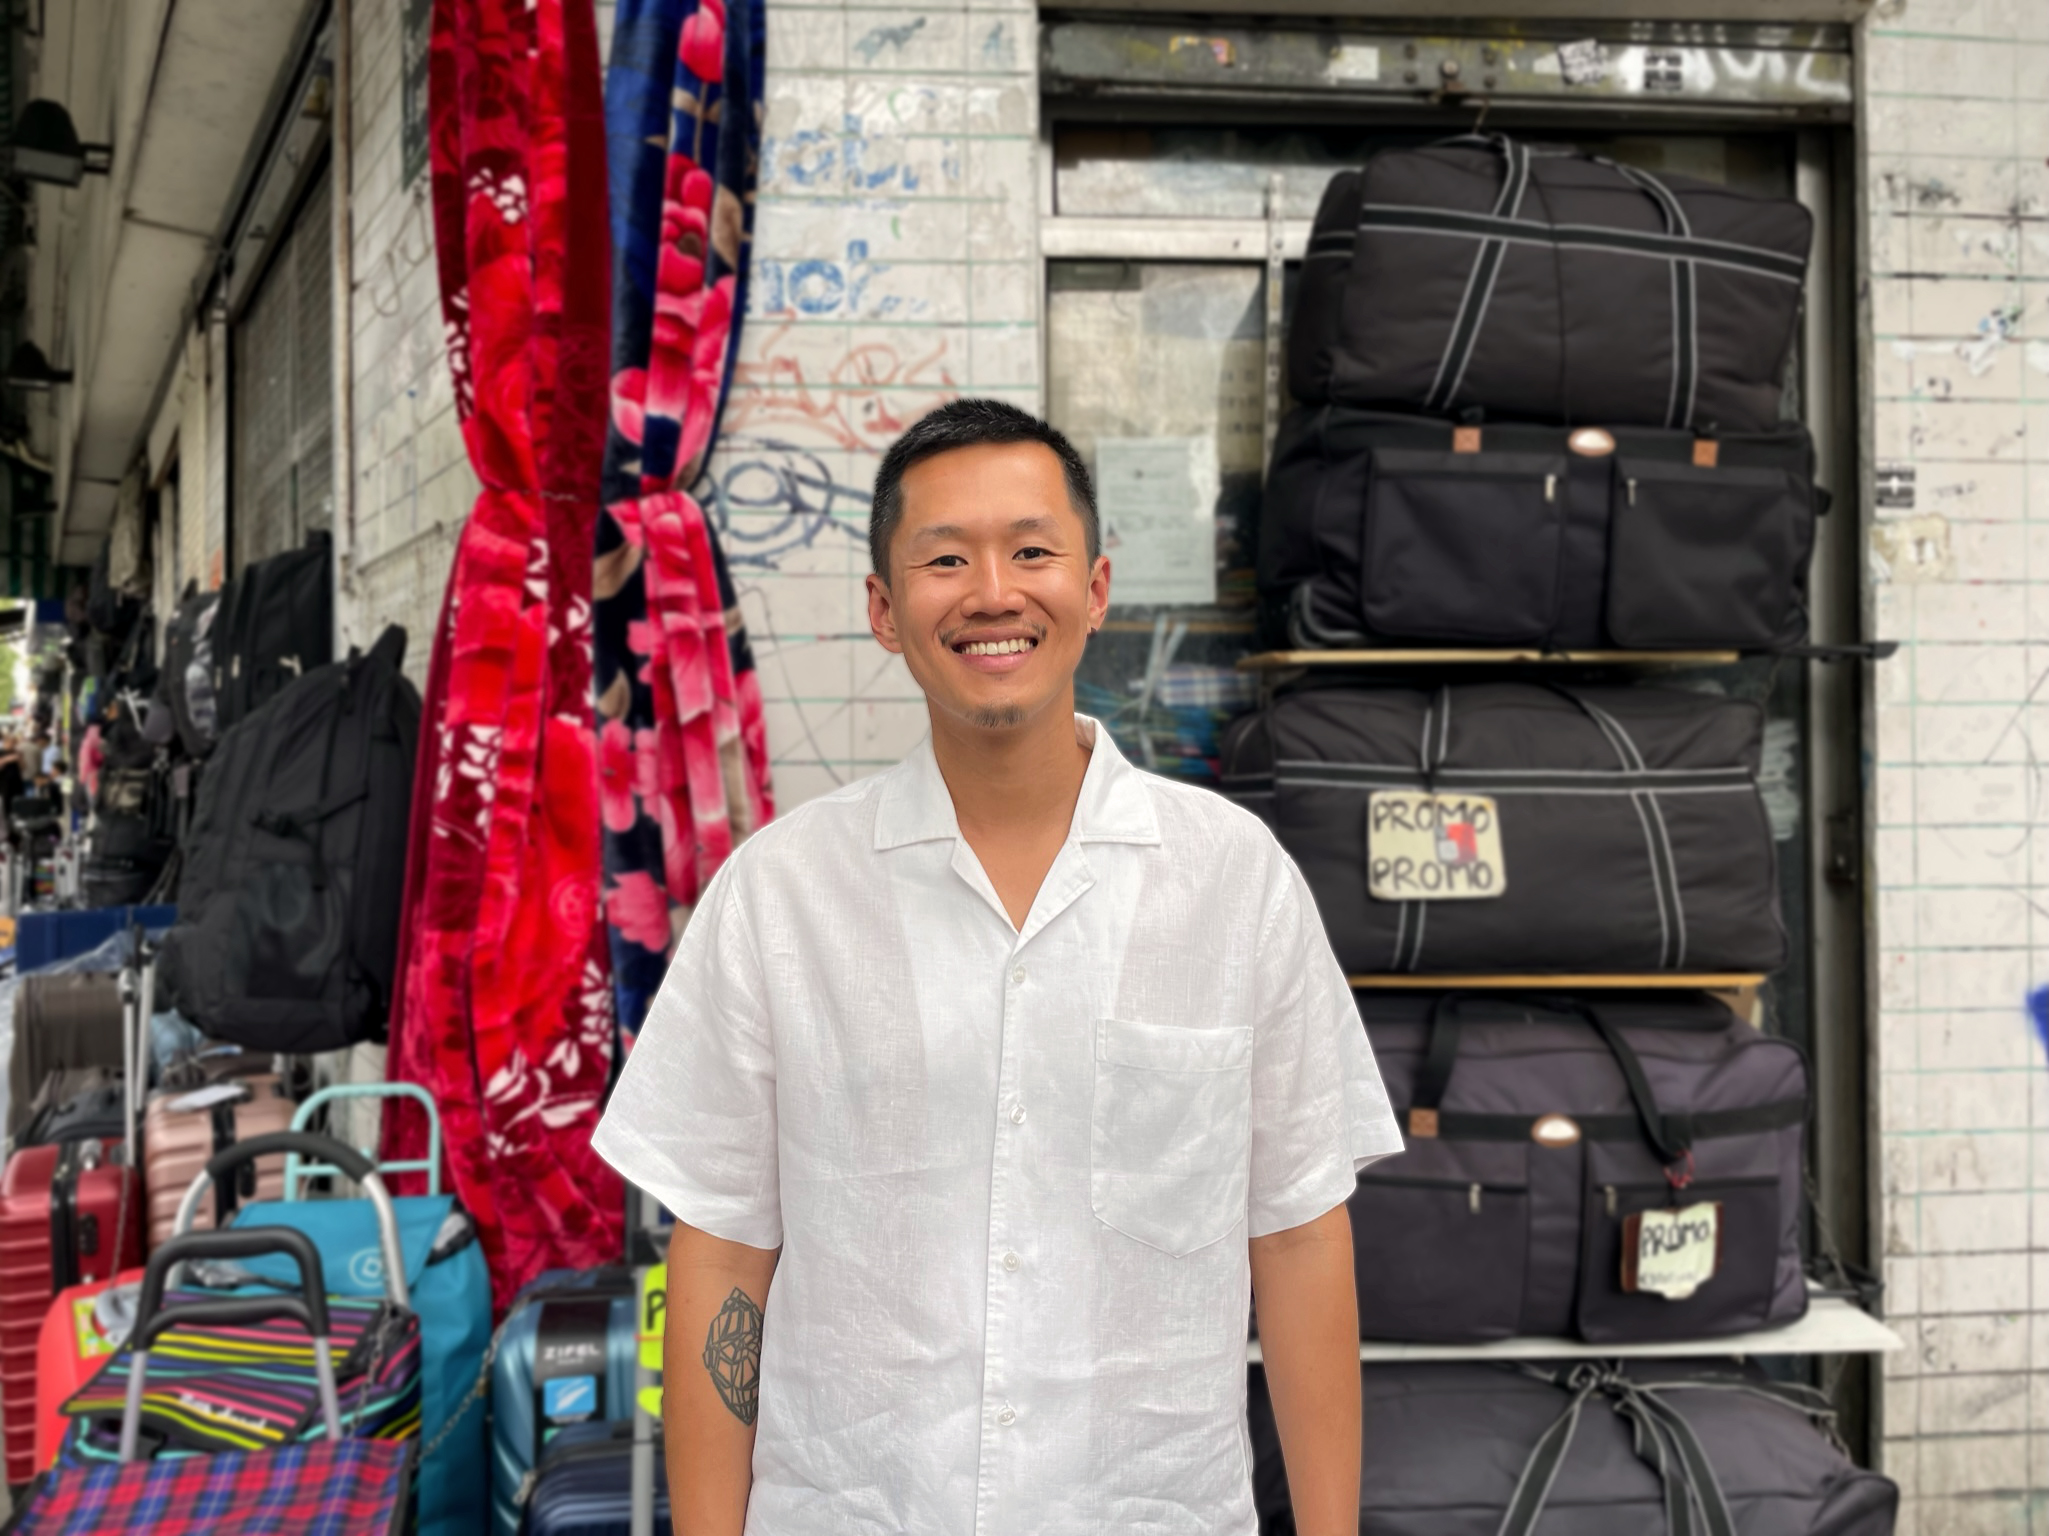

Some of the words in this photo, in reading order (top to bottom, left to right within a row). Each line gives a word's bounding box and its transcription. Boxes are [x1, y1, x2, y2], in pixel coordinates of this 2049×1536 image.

[1373, 799, 1491, 833] PROMO
[1372, 857, 1494, 892] PROMO
[1641, 1220, 1710, 1258] PROMO
